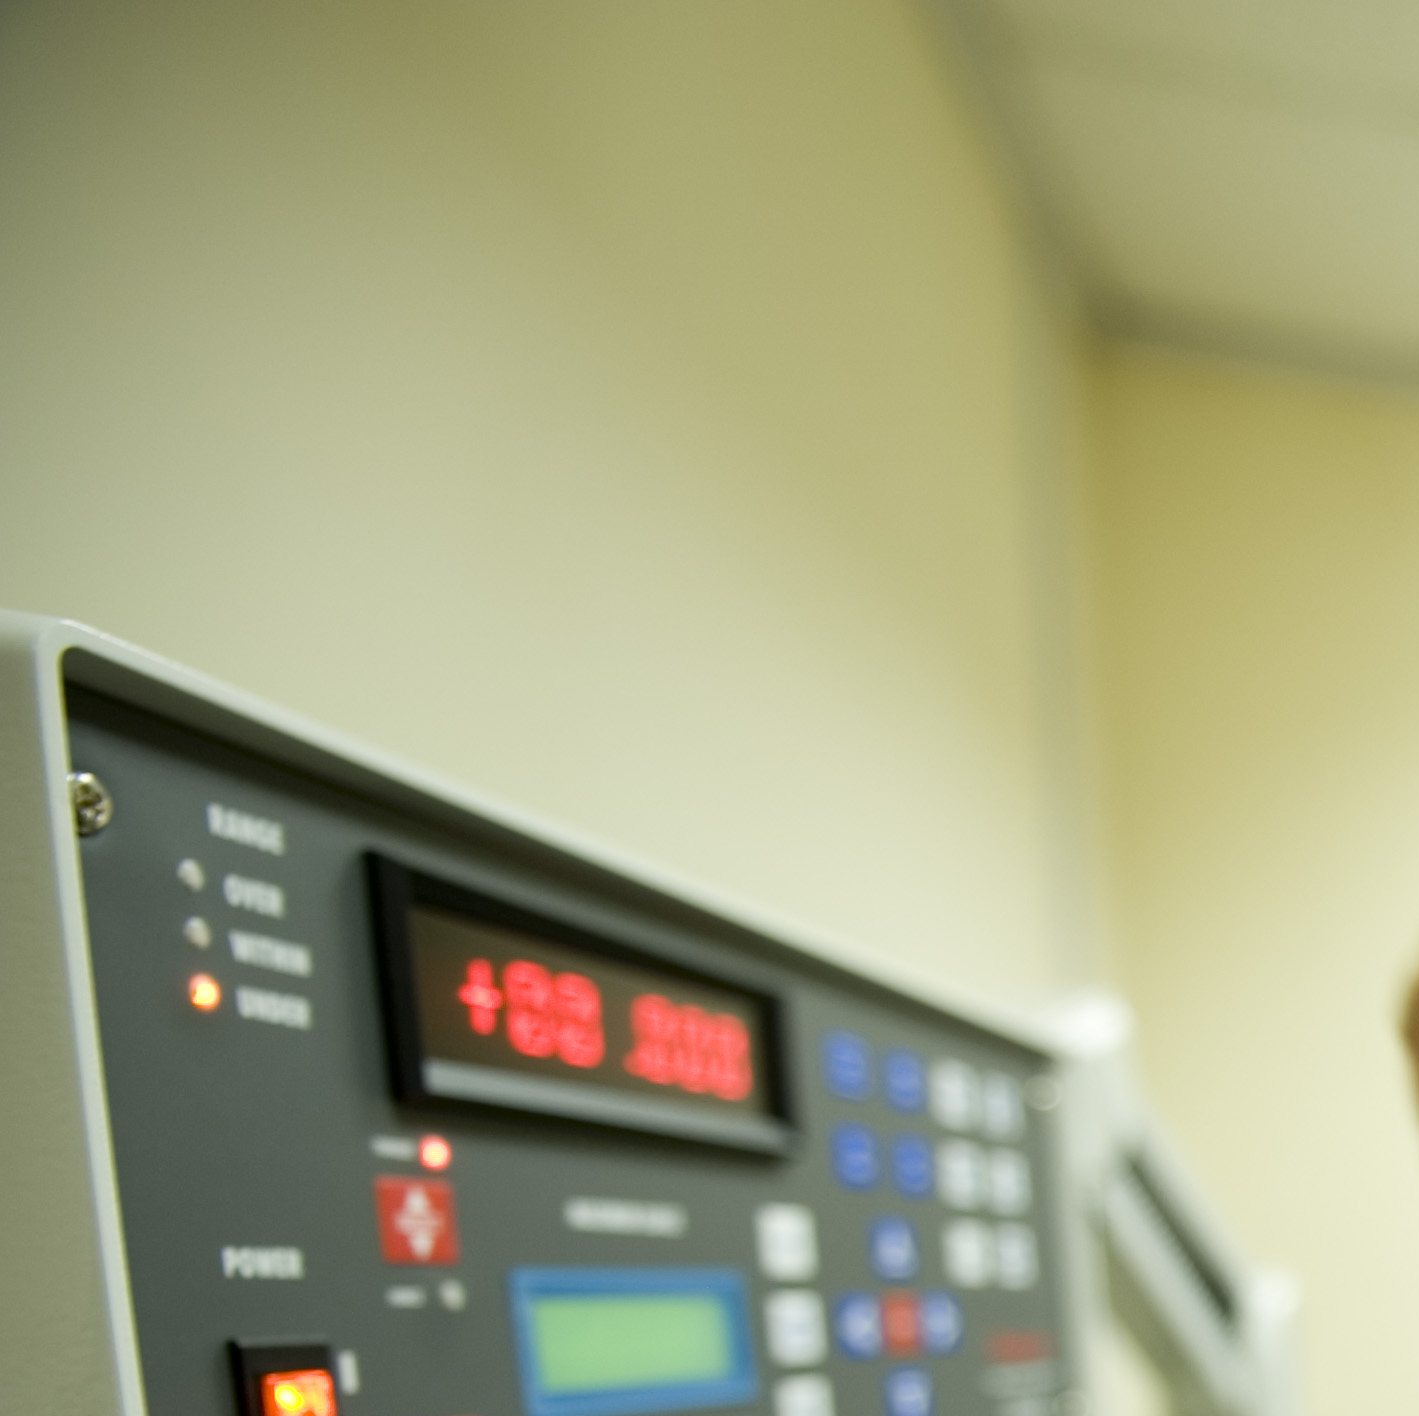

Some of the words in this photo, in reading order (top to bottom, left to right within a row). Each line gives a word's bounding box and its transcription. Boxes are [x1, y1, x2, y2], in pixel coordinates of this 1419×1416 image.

[206, 802, 285, 856] RANGE
[223, 873, 286, 919] OVER
[228, 928, 313, 978] WITHIN
[235, 984, 312, 1031] UNDER
[221, 1245, 304, 1280] POWER
